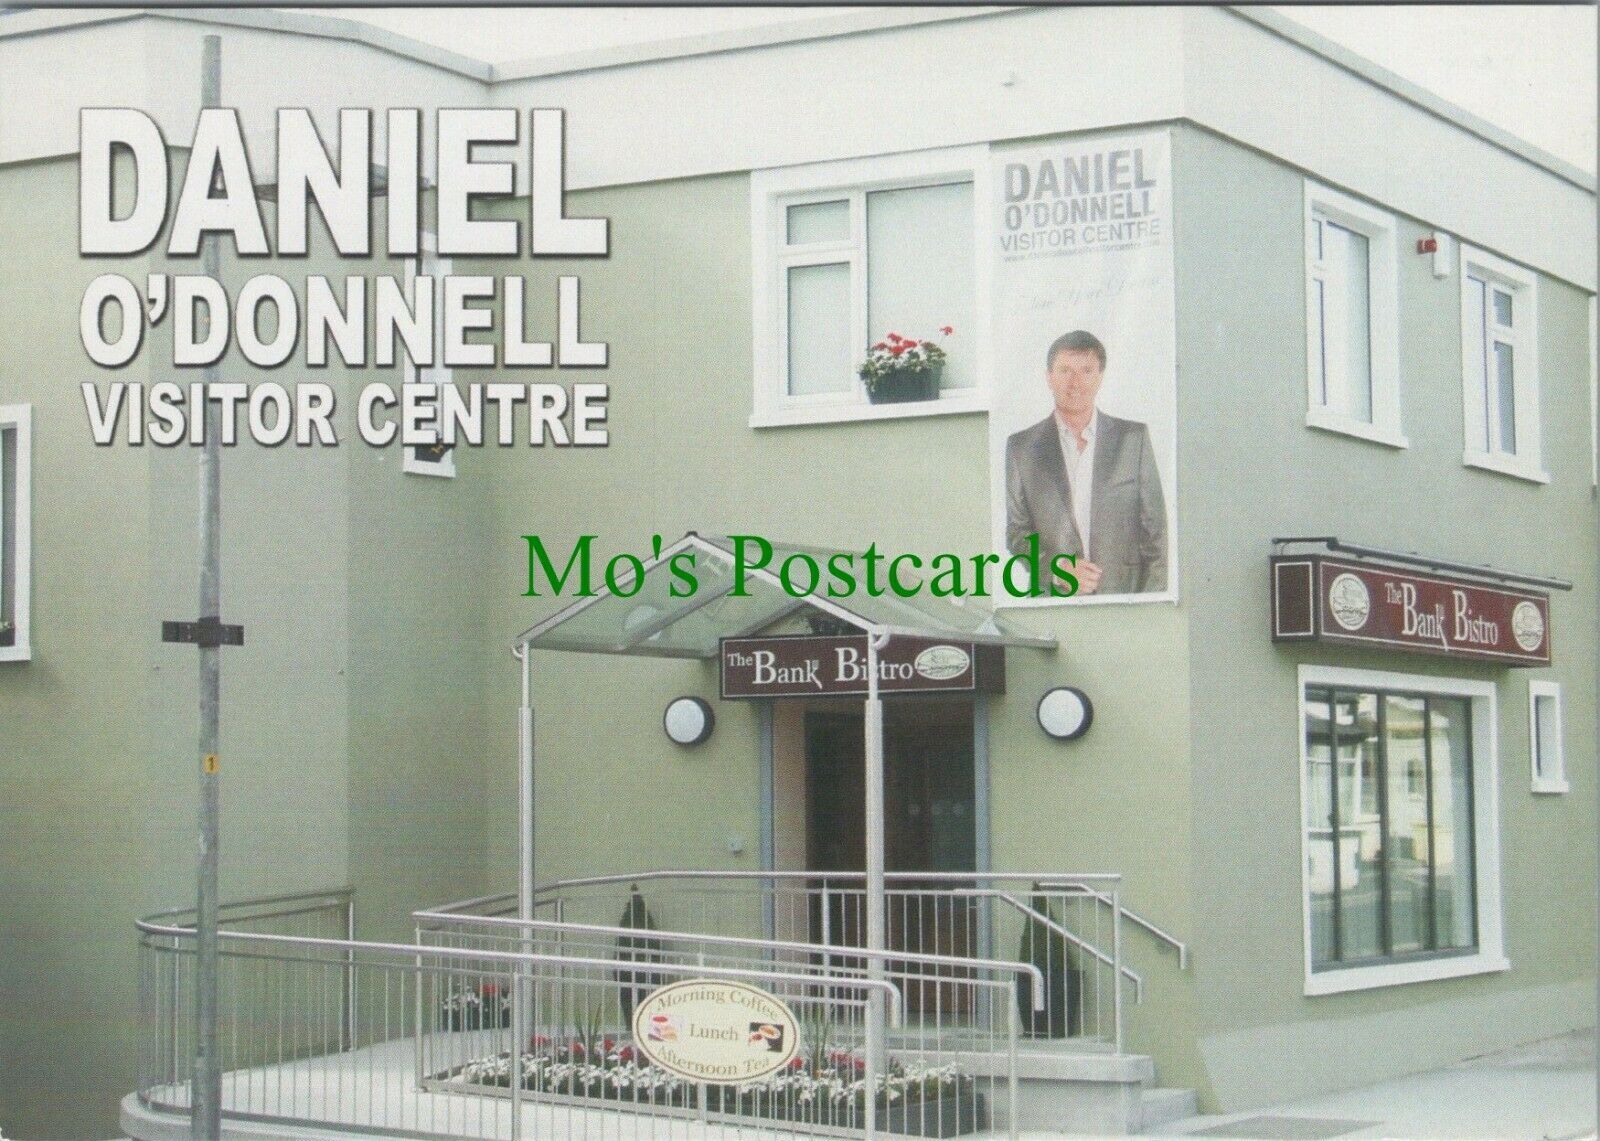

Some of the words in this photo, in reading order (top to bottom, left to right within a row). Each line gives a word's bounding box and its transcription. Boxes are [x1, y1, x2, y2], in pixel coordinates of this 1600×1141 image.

[1004, 148, 1157, 202] DANIEL
[1004, 191, 1155, 231] O'DONNELL
[1000, 228, 1077, 253] VISITOR
[1082, 218, 1161, 245] CENTRE
[1385, 582, 1402, 605] The
[1402, 582, 1448, 651] Bank
[1453, 590, 1498, 645] Bistro
[727, 652, 752, 667] The
[752, 650, 822, 689] Bank
[834, 646, 914, 682] Bitro
[657, 989, 725, 1011] Morning
[730, 990, 778, 1019] Coffee
[689, 1023, 739, 1041] Lunch
[657, 1046, 738, 1076] Afternoon
